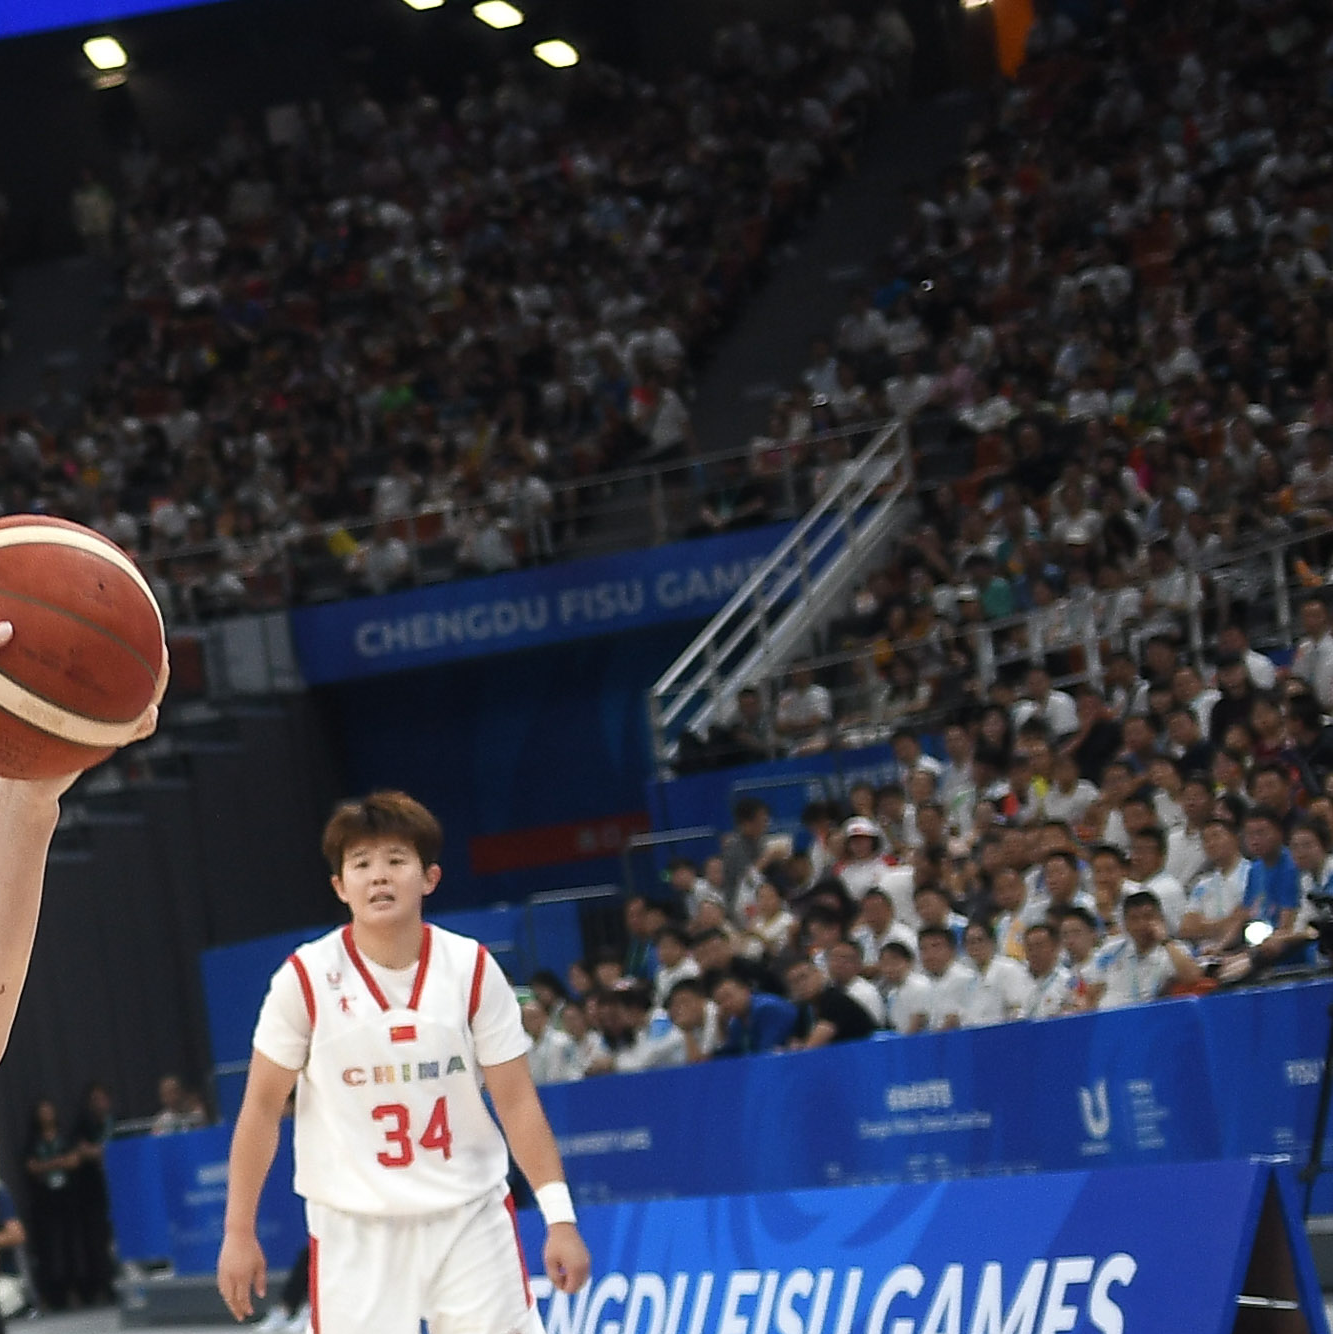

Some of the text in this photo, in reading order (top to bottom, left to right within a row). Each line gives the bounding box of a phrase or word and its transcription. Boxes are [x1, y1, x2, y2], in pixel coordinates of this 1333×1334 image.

[357, 597, 547, 657] CHENGDU
[559, 579, 642, 626] FISU
[341, 1055, 467, 1087] CHINA
[371, 1096, 454, 1168] 34
